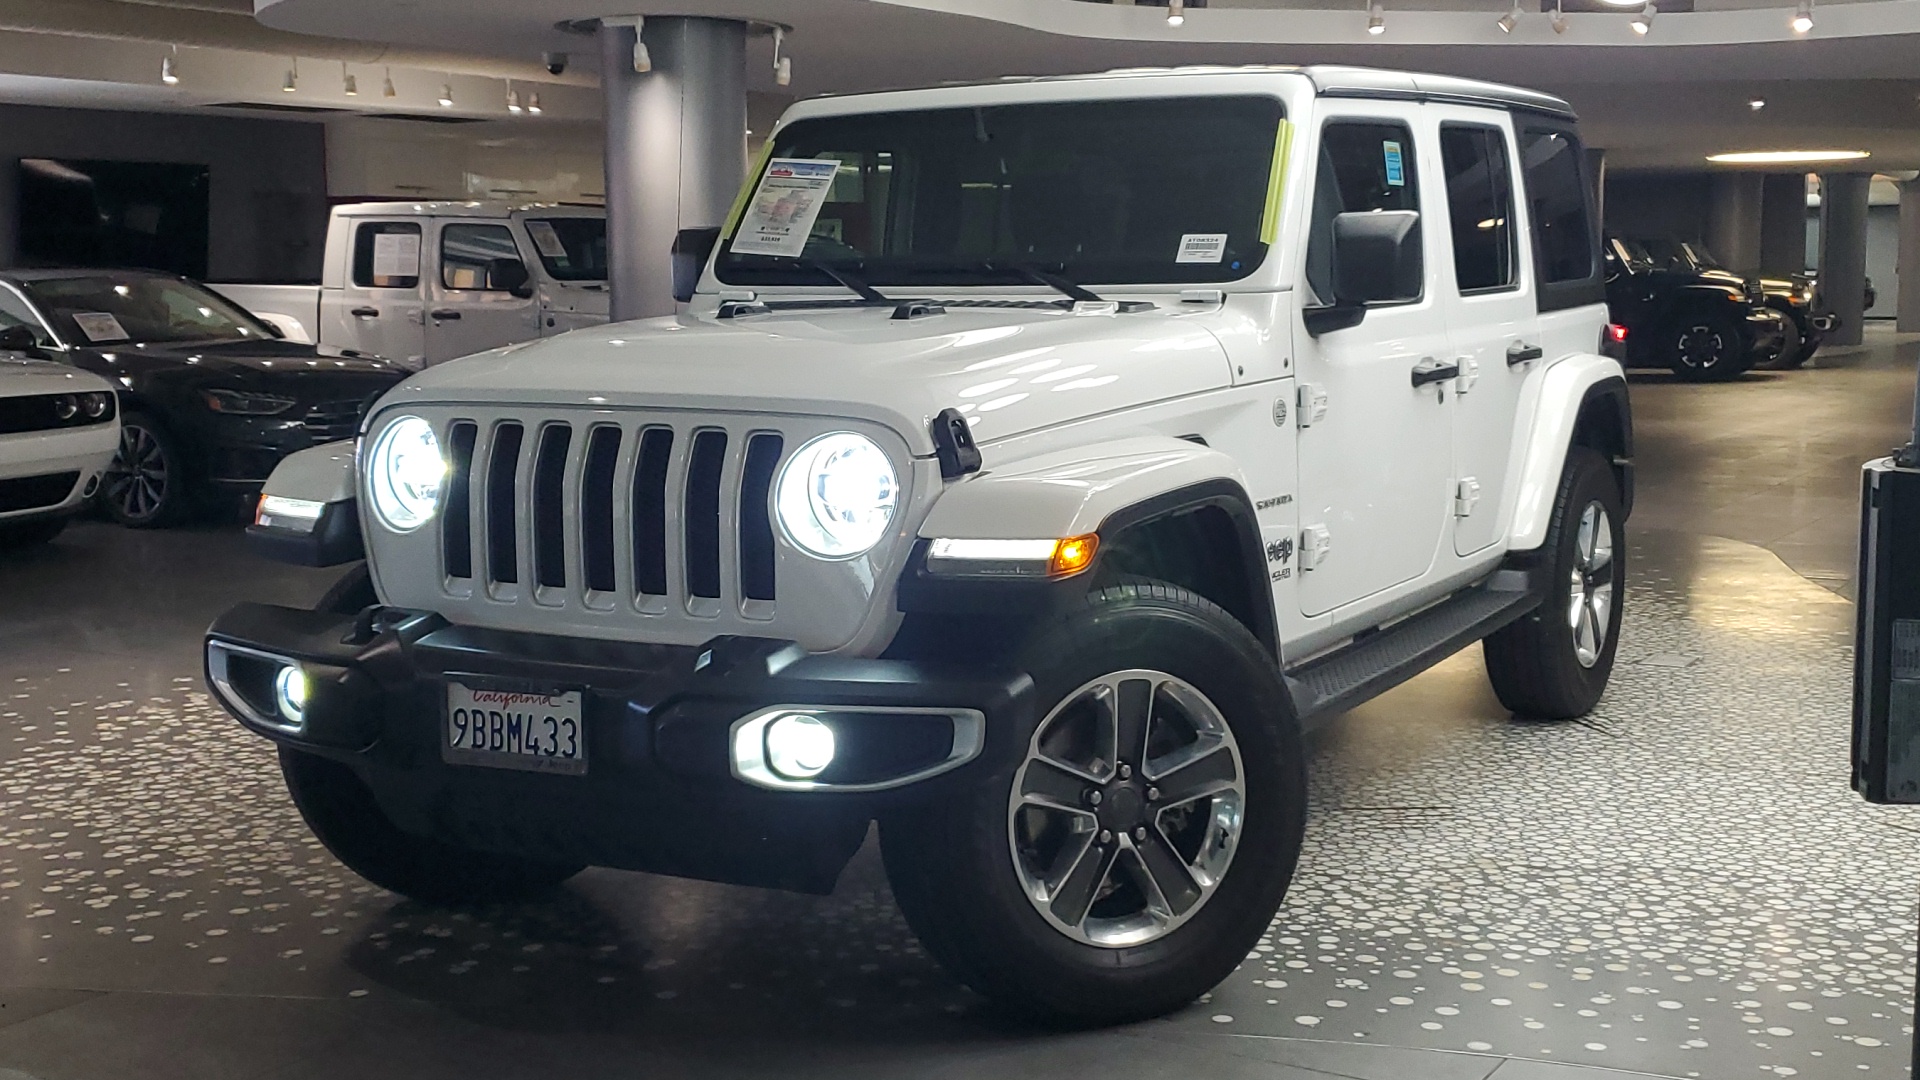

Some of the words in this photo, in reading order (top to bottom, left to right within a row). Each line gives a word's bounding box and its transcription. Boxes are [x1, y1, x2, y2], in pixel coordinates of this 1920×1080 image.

[1256, 494, 1293, 510] SAHARA
[1266, 536, 1293, 564] eep
[453, 708, 577, 759] 9BBM433
